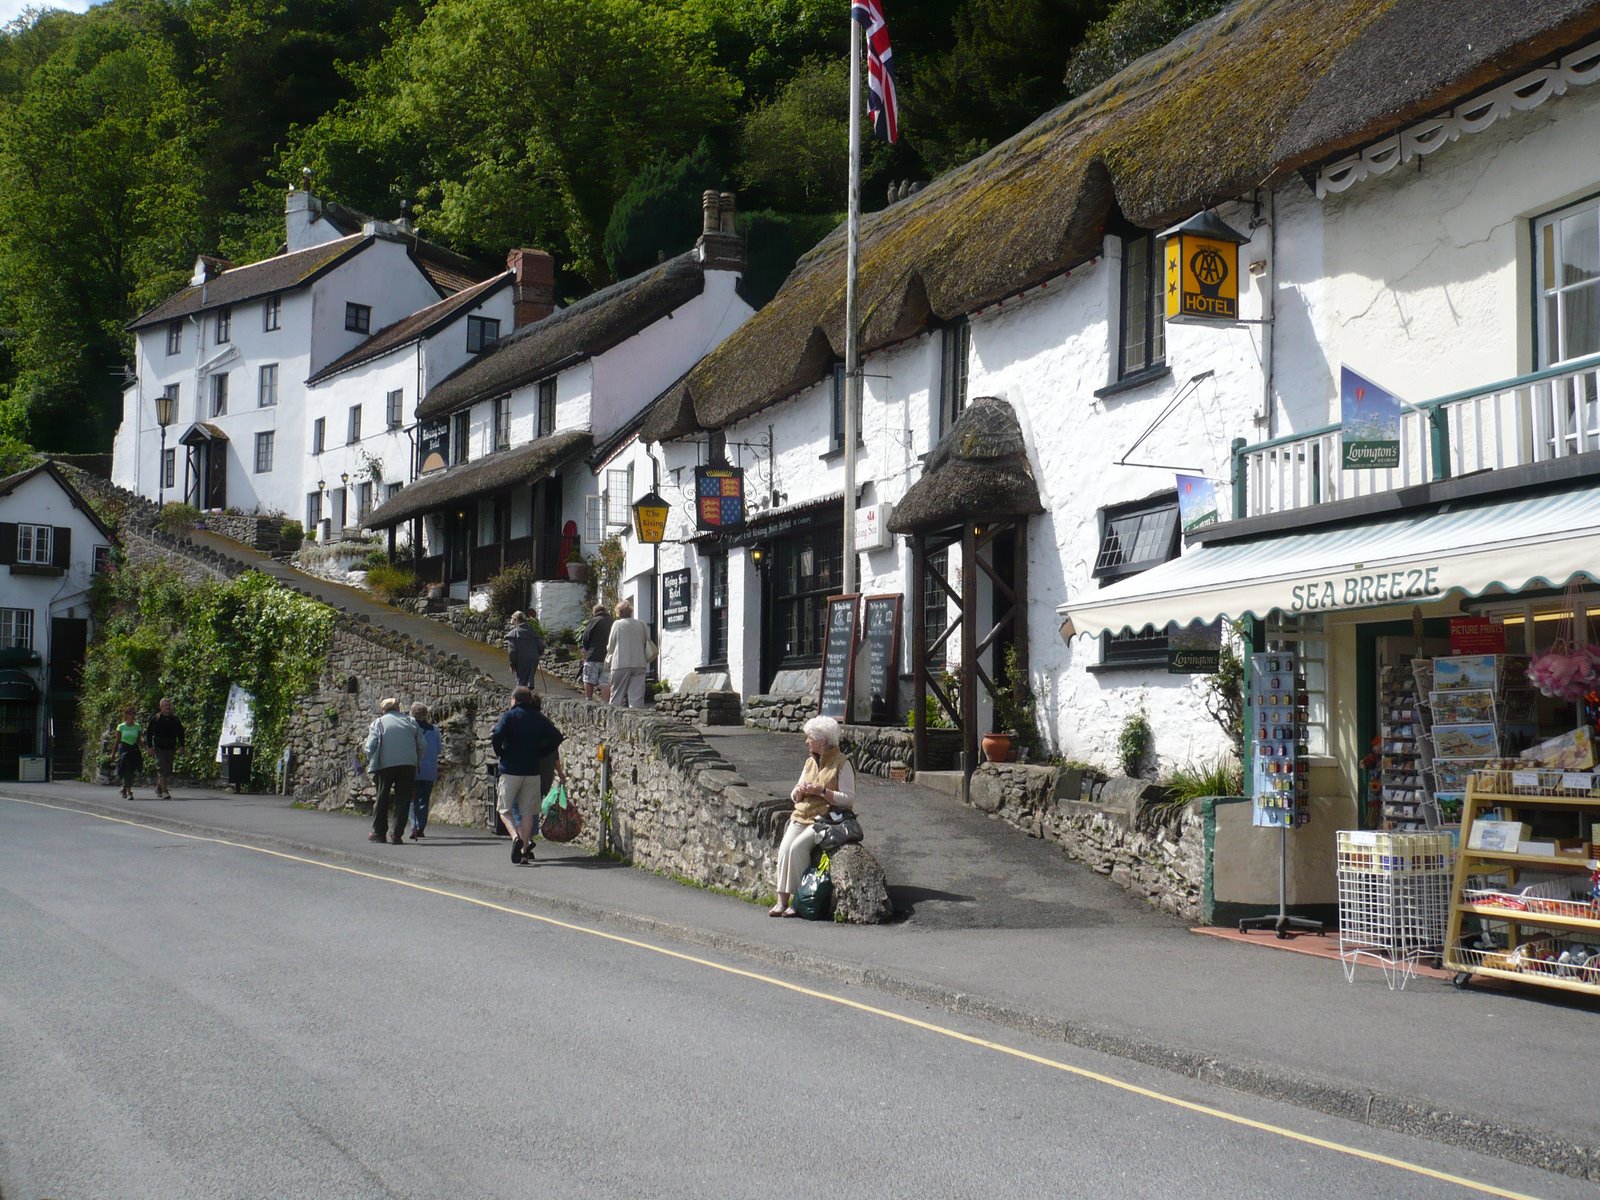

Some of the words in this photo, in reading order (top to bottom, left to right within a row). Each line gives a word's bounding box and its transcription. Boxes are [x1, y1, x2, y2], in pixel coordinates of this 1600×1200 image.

[1186, 295, 1233, 314] HOTEL
[1346, 443, 1397, 463] Lovington's
[643, 520, 664, 529] Rising
[645, 529, 659, 537] Sun
[1291, 581, 1338, 611] SEA
[1343, 567, 1440, 605] BREEZE
[1451, 625, 1479, 635] PICTURE
[1480, 624, 1504, 634] PRINTS
[1172, 651, 1218, 668] Lovington's
